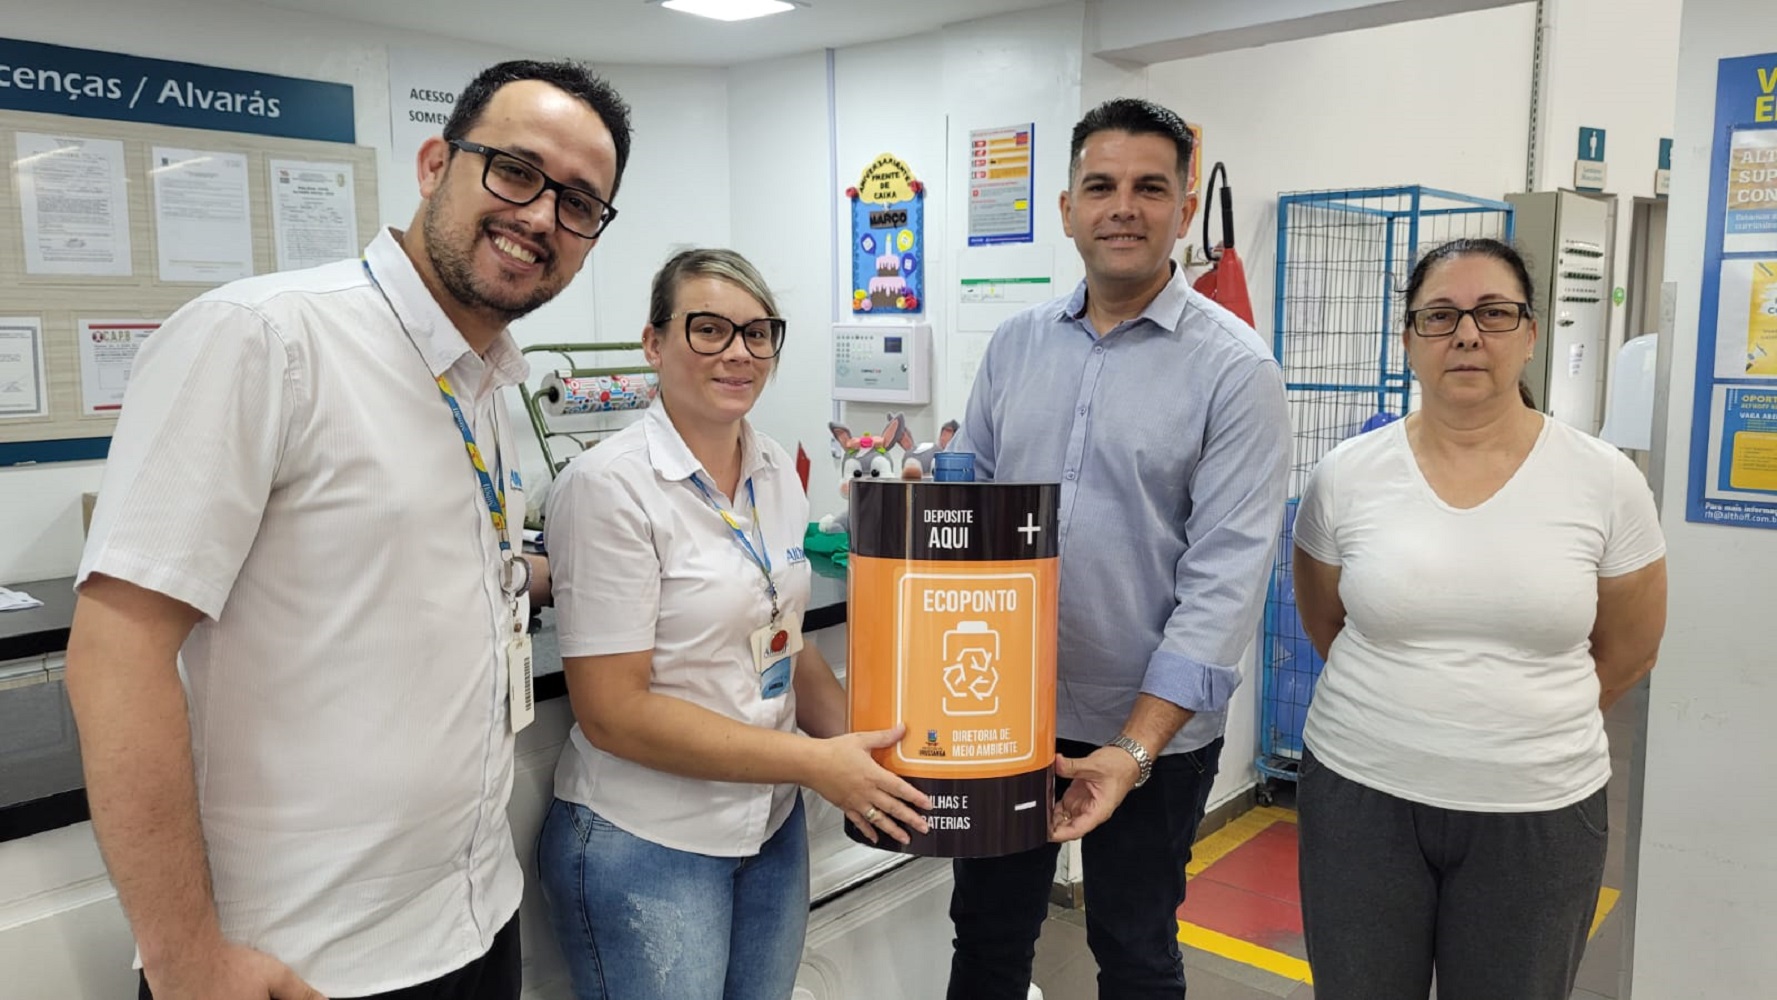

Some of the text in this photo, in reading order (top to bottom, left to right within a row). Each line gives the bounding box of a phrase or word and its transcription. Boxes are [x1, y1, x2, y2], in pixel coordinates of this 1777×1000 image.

[129, 76, 148, 109] /
[157, 79, 281, 118] Alvarás
[410, 88, 454, 104] ACESSO
[1755, 95, 1777, 122] E
[873, 191, 897, 200] CAIXA
[923, 509, 974, 524] DEPOSITE
[928, 526, 969, 550] AQUI
[923, 588, 1017, 613] ECOPONTO
[952, 728, 1011, 742] DIRETORIA DE
[952, 741, 1018, 757] MEIO AMBIENTE
[929, 795, 969, 809] ILHAS E
